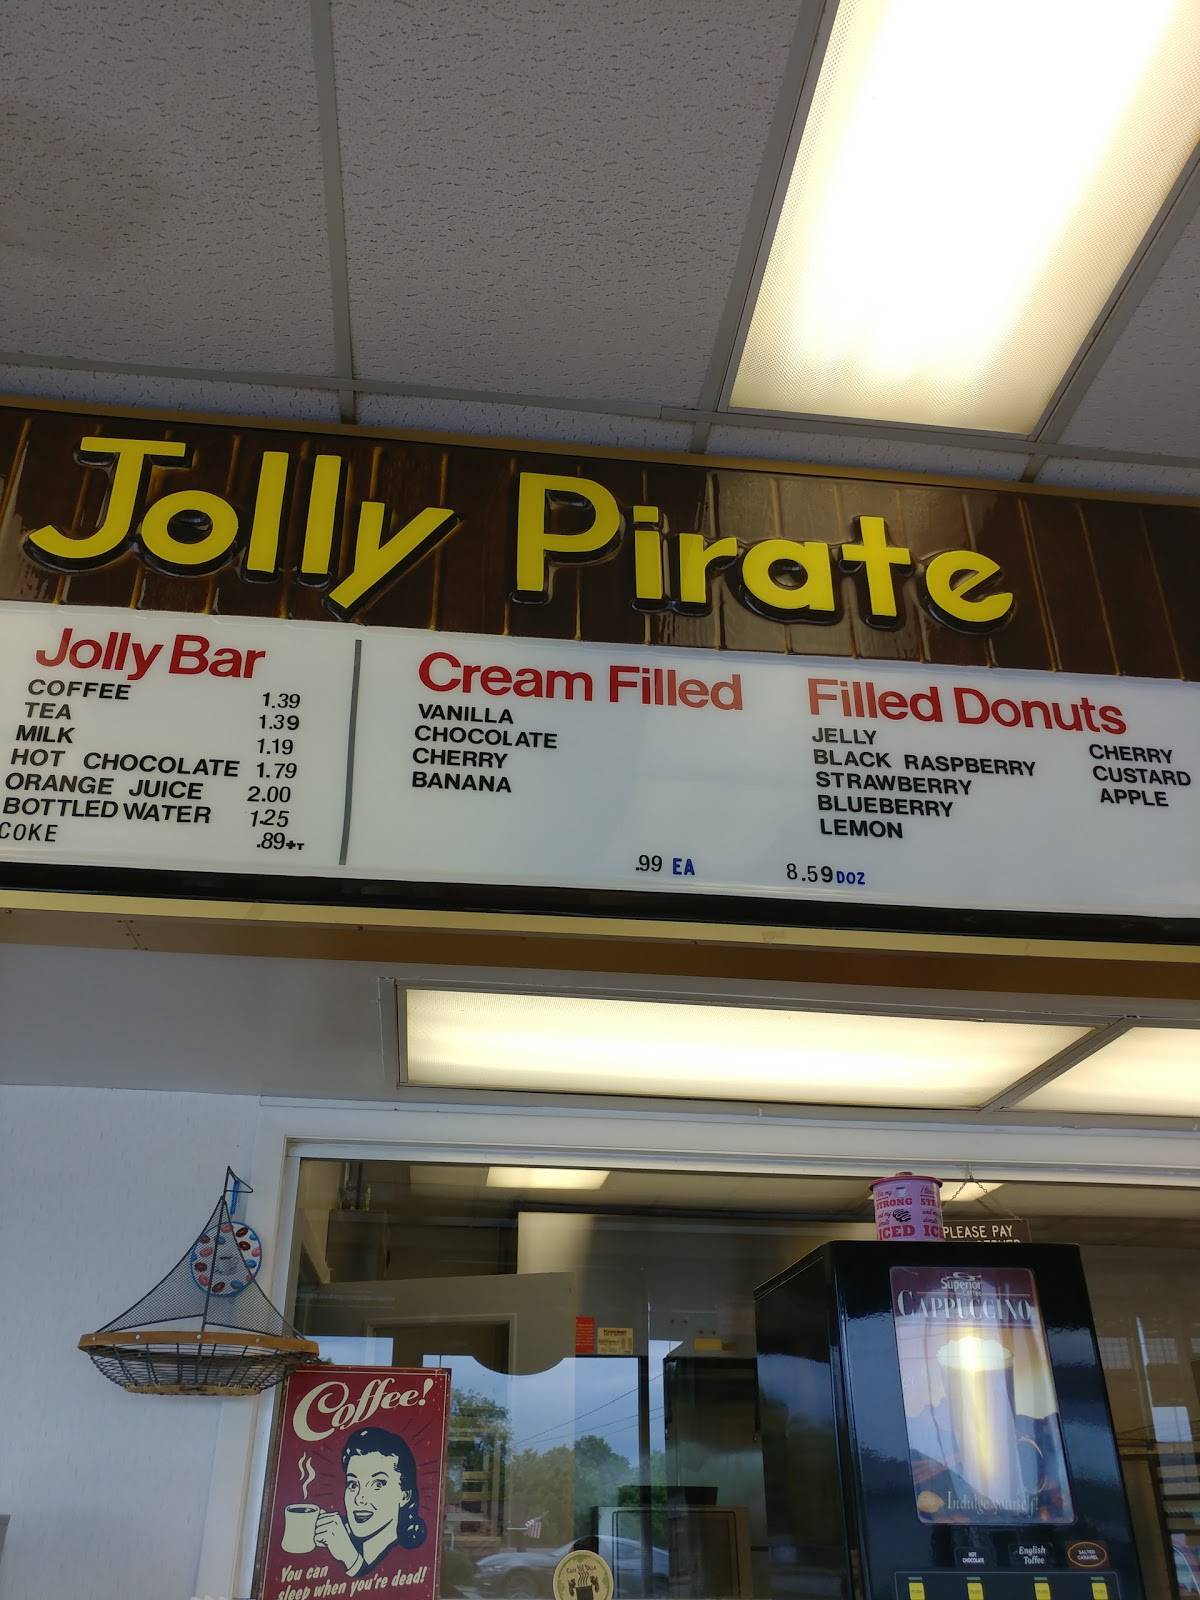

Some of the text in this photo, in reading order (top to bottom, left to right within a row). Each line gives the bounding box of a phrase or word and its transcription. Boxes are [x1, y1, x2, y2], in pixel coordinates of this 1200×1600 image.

[28, 436, 1014, 623] Jolly Pirate
[36, 628, 266, 681] Jolly Bar
[28, 679, 132, 700] COFFEE
[418, 651, 744, 711] Cream Filled
[24, 701, 72, 720] TEA
[262, 692, 301, 709] 1.39
[807, 677, 1128, 735] Filled Donuts
[258, 714, 300, 731] 1.39
[418, 704, 514, 724] VANILLA
[15, 725, 76, 744] MILK
[414, 725, 558, 749] CHOCOLATE
[812, 727, 877, 745] JELLY
[256, 738, 294, 755] 1.19
[1088, 743, 1173, 764] CHERRY
[10, 748, 241, 778] HOT CHOCOLATE
[412, 748, 508, 769] CHERRY
[813, 749, 1036, 777] BLACK RASPBERRY
[256, 762, 298, 779] 1.79
[1092, 765, 1192, 787] CUSTARD
[5, 772, 204, 800] ORANGE JUICE
[411, 771, 512, 793] BANANA
[815, 771, 972, 796] STRAWBERRY
[247, 786, 292, 803] 2.00
[1099, 787, 1169, 807] APPLE
[2, 797, 212, 824] BOTTLED WATER
[817, 794, 953, 818] BLUEBERRY
[250, 809, 290, 828] 1.25
[820, 818, 904, 839] LEMON
[0, 821, 59, 843] COKE
[672, 857, 696, 876] EA
[786, 863, 834, 884] 8.59
[879, 1224, 915, 1241] ICED
[943, 1224, 1013, 1239] PLEASE PAY
[940, 1277, 982, 1291] Superior
[292, 1377, 434, 1442] Coffee!
[1018, 1545, 1046, 1556] English
[1023, 1554, 1045, 1565] Toffee
[277, 1566, 429, 1600] sleep when you're dead!
[281, 1565, 329, 1583] You can
